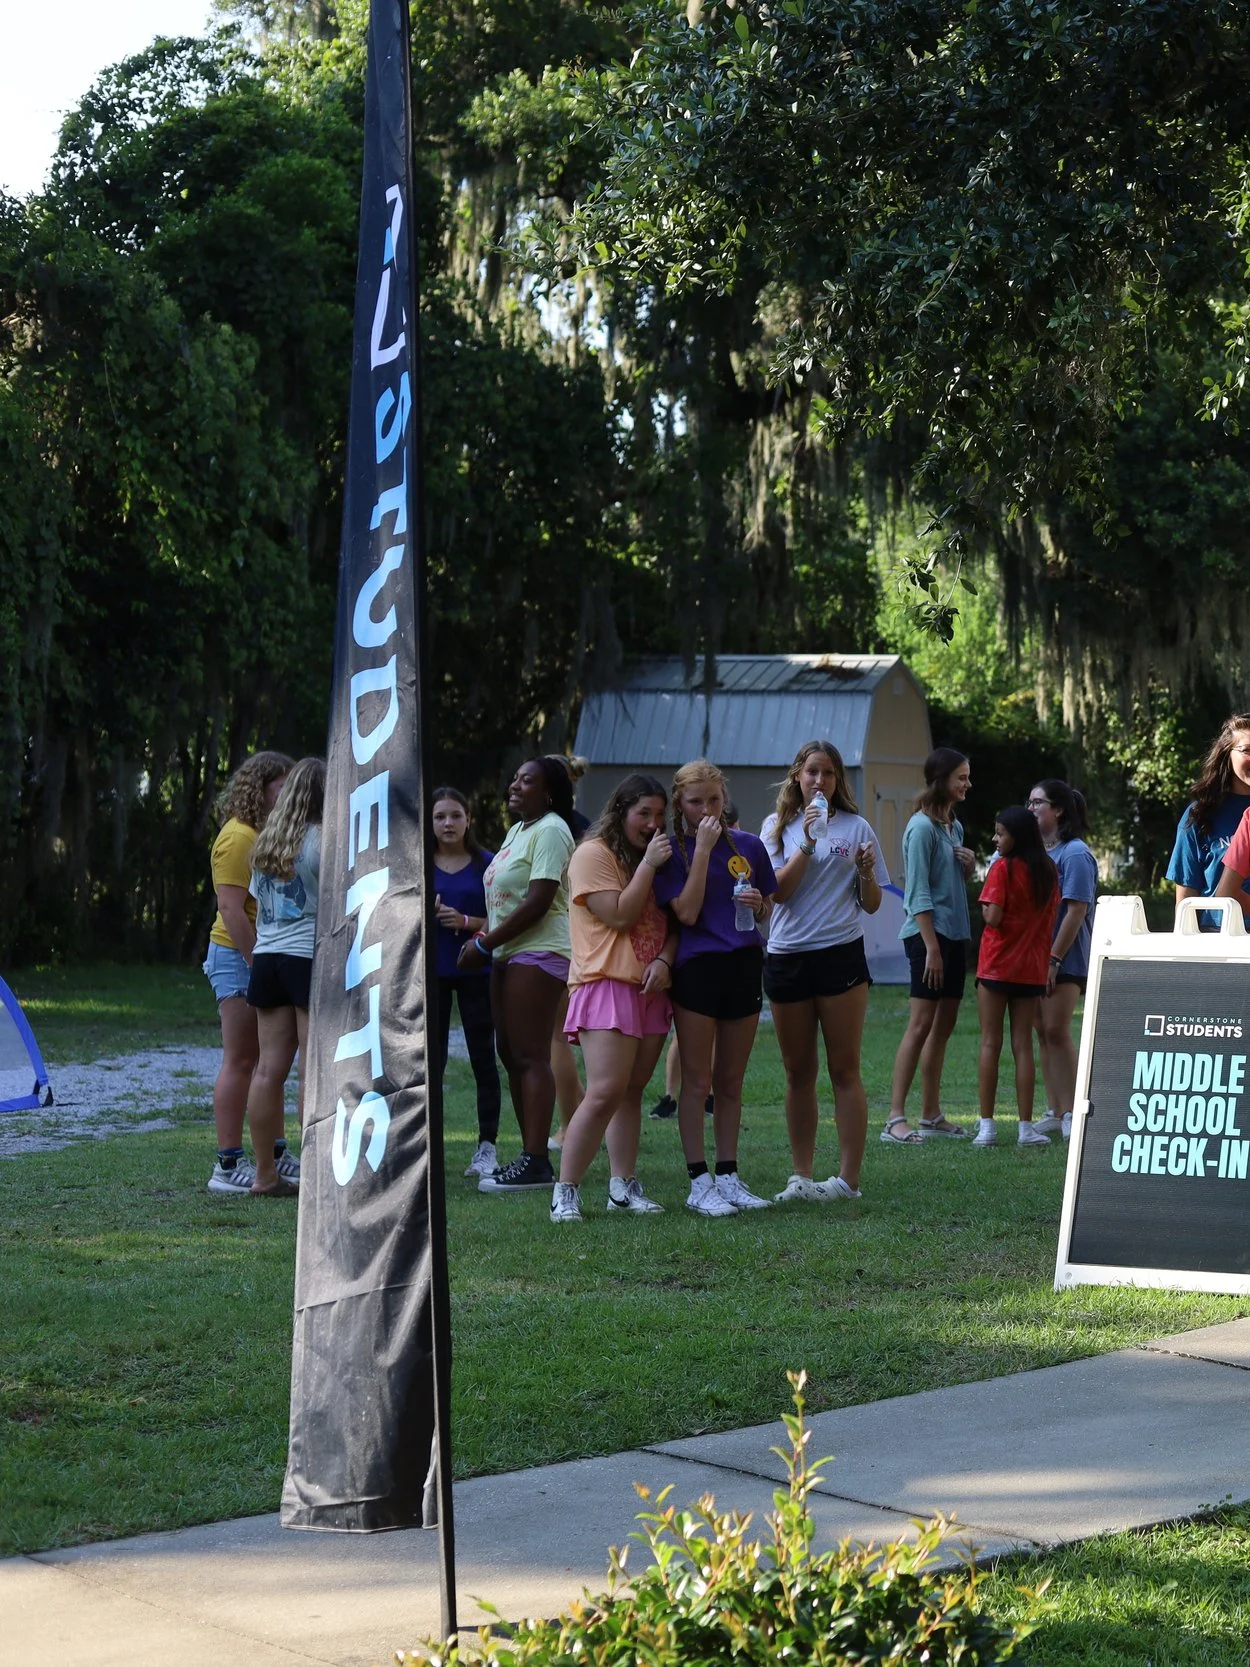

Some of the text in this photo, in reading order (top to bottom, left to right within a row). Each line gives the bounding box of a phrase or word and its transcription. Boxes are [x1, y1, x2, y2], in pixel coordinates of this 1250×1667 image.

[330, 370, 413, 1188] STUDENTS
[1166, 1023, 1243, 1039] STUDENTS
[1167, 1016, 1242, 1025] CORNERSTONE
[1132, 1051, 1247, 1094] MIDDLE
[1127, 1092, 1241, 1136] SCHOOL
[1111, 1134, 1250, 1180] CHECK-IN
